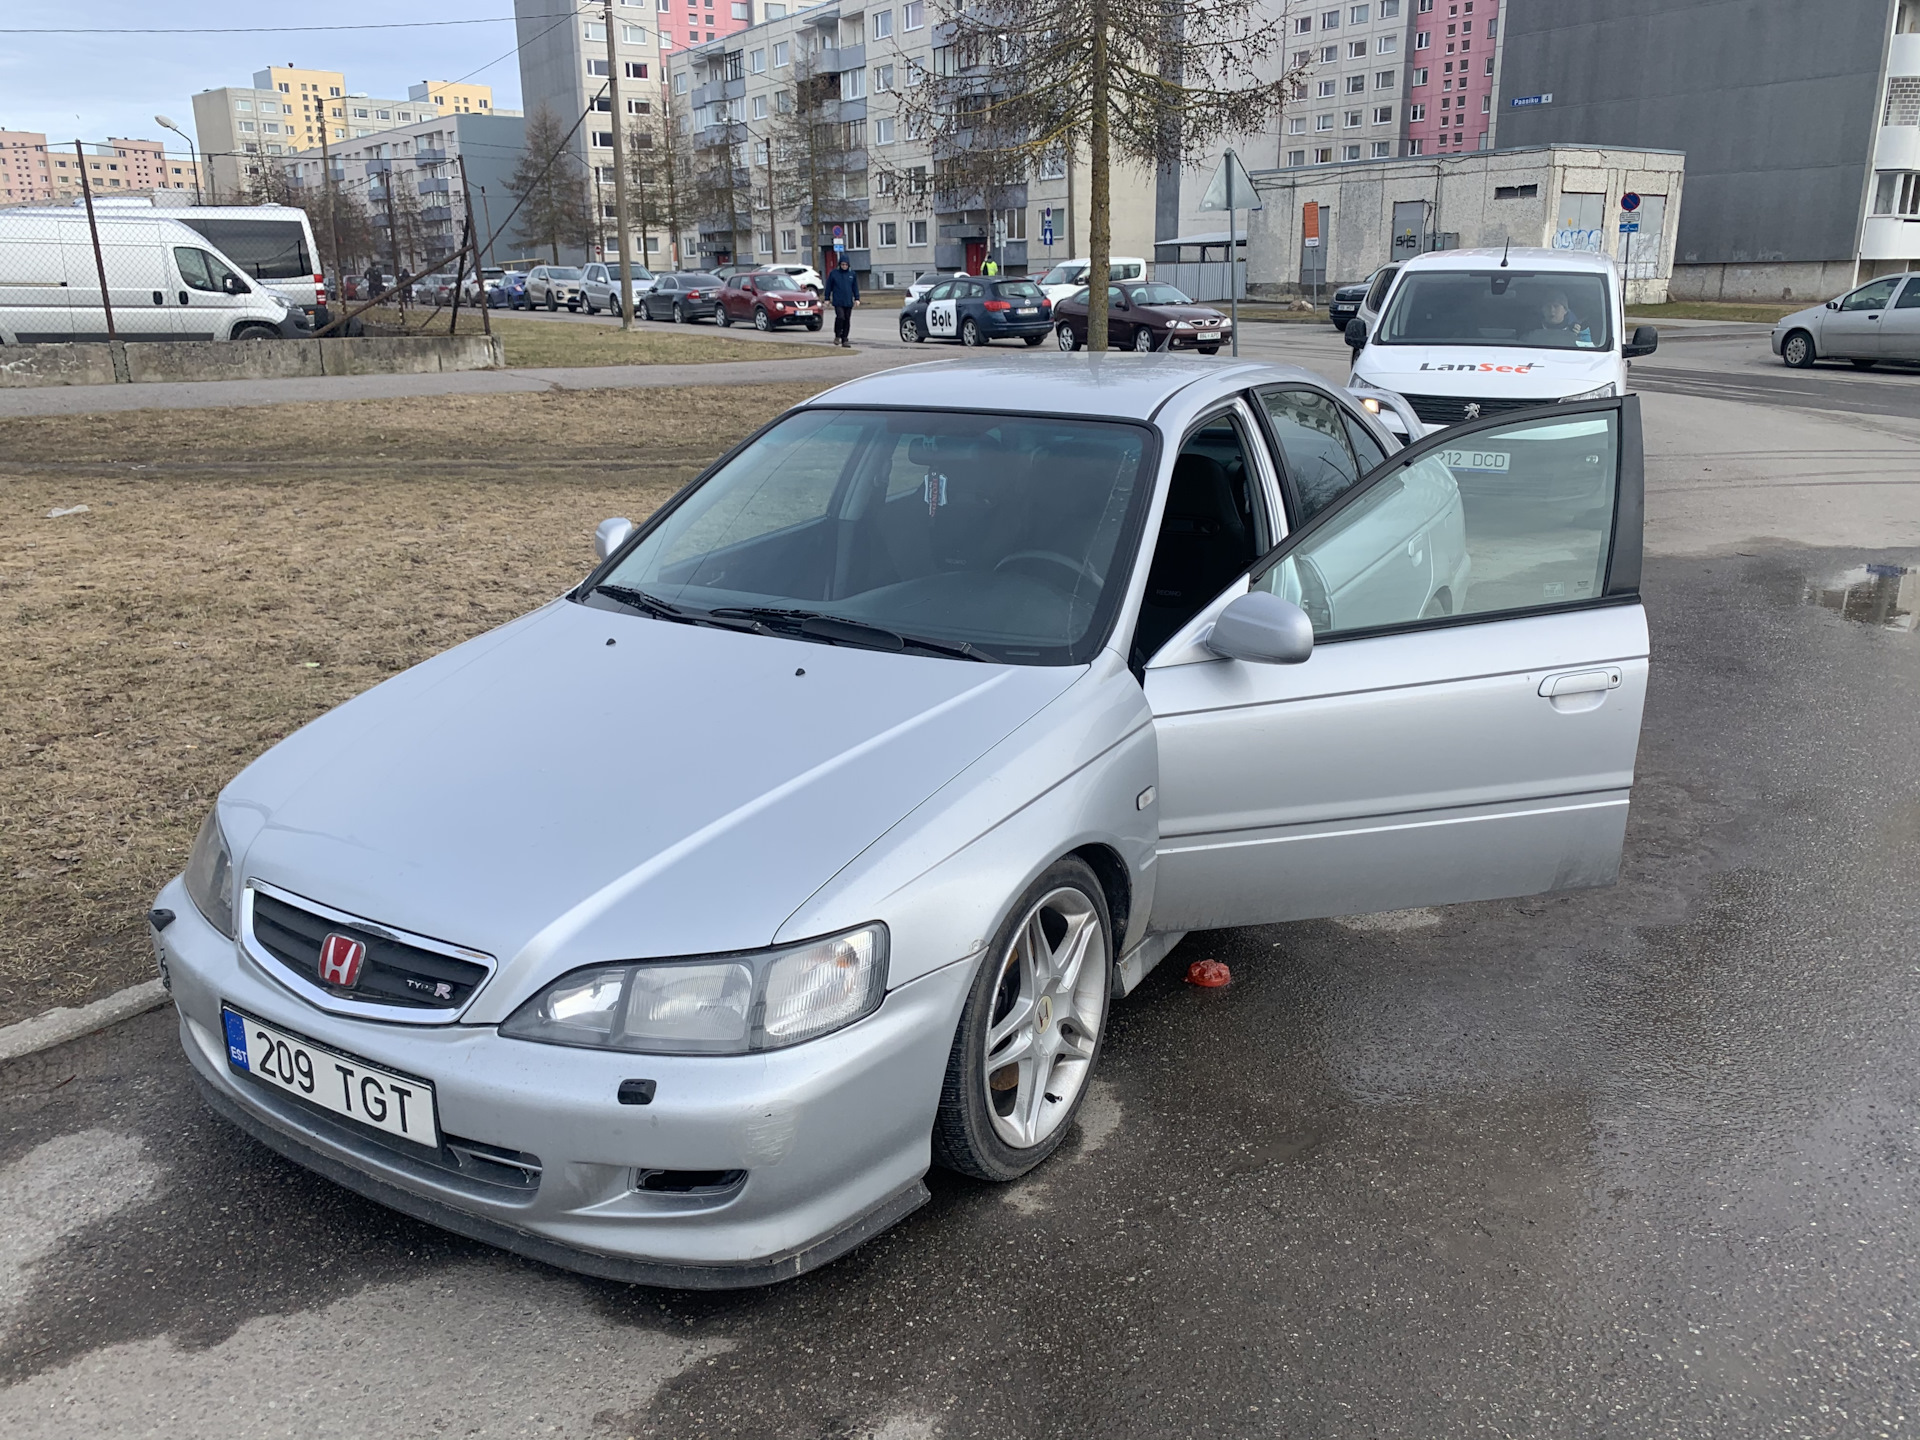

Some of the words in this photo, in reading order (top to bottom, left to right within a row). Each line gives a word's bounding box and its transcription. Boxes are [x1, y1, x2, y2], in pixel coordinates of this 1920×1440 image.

[931, 310, 952, 331] Bolt
[1473, 453, 1505, 468] DCD
[434, 982, 451, 999] R
[230, 1046, 248, 1064] EST
[256, 1031, 315, 1094] 209
[335, 1063, 412, 1133] TGT
